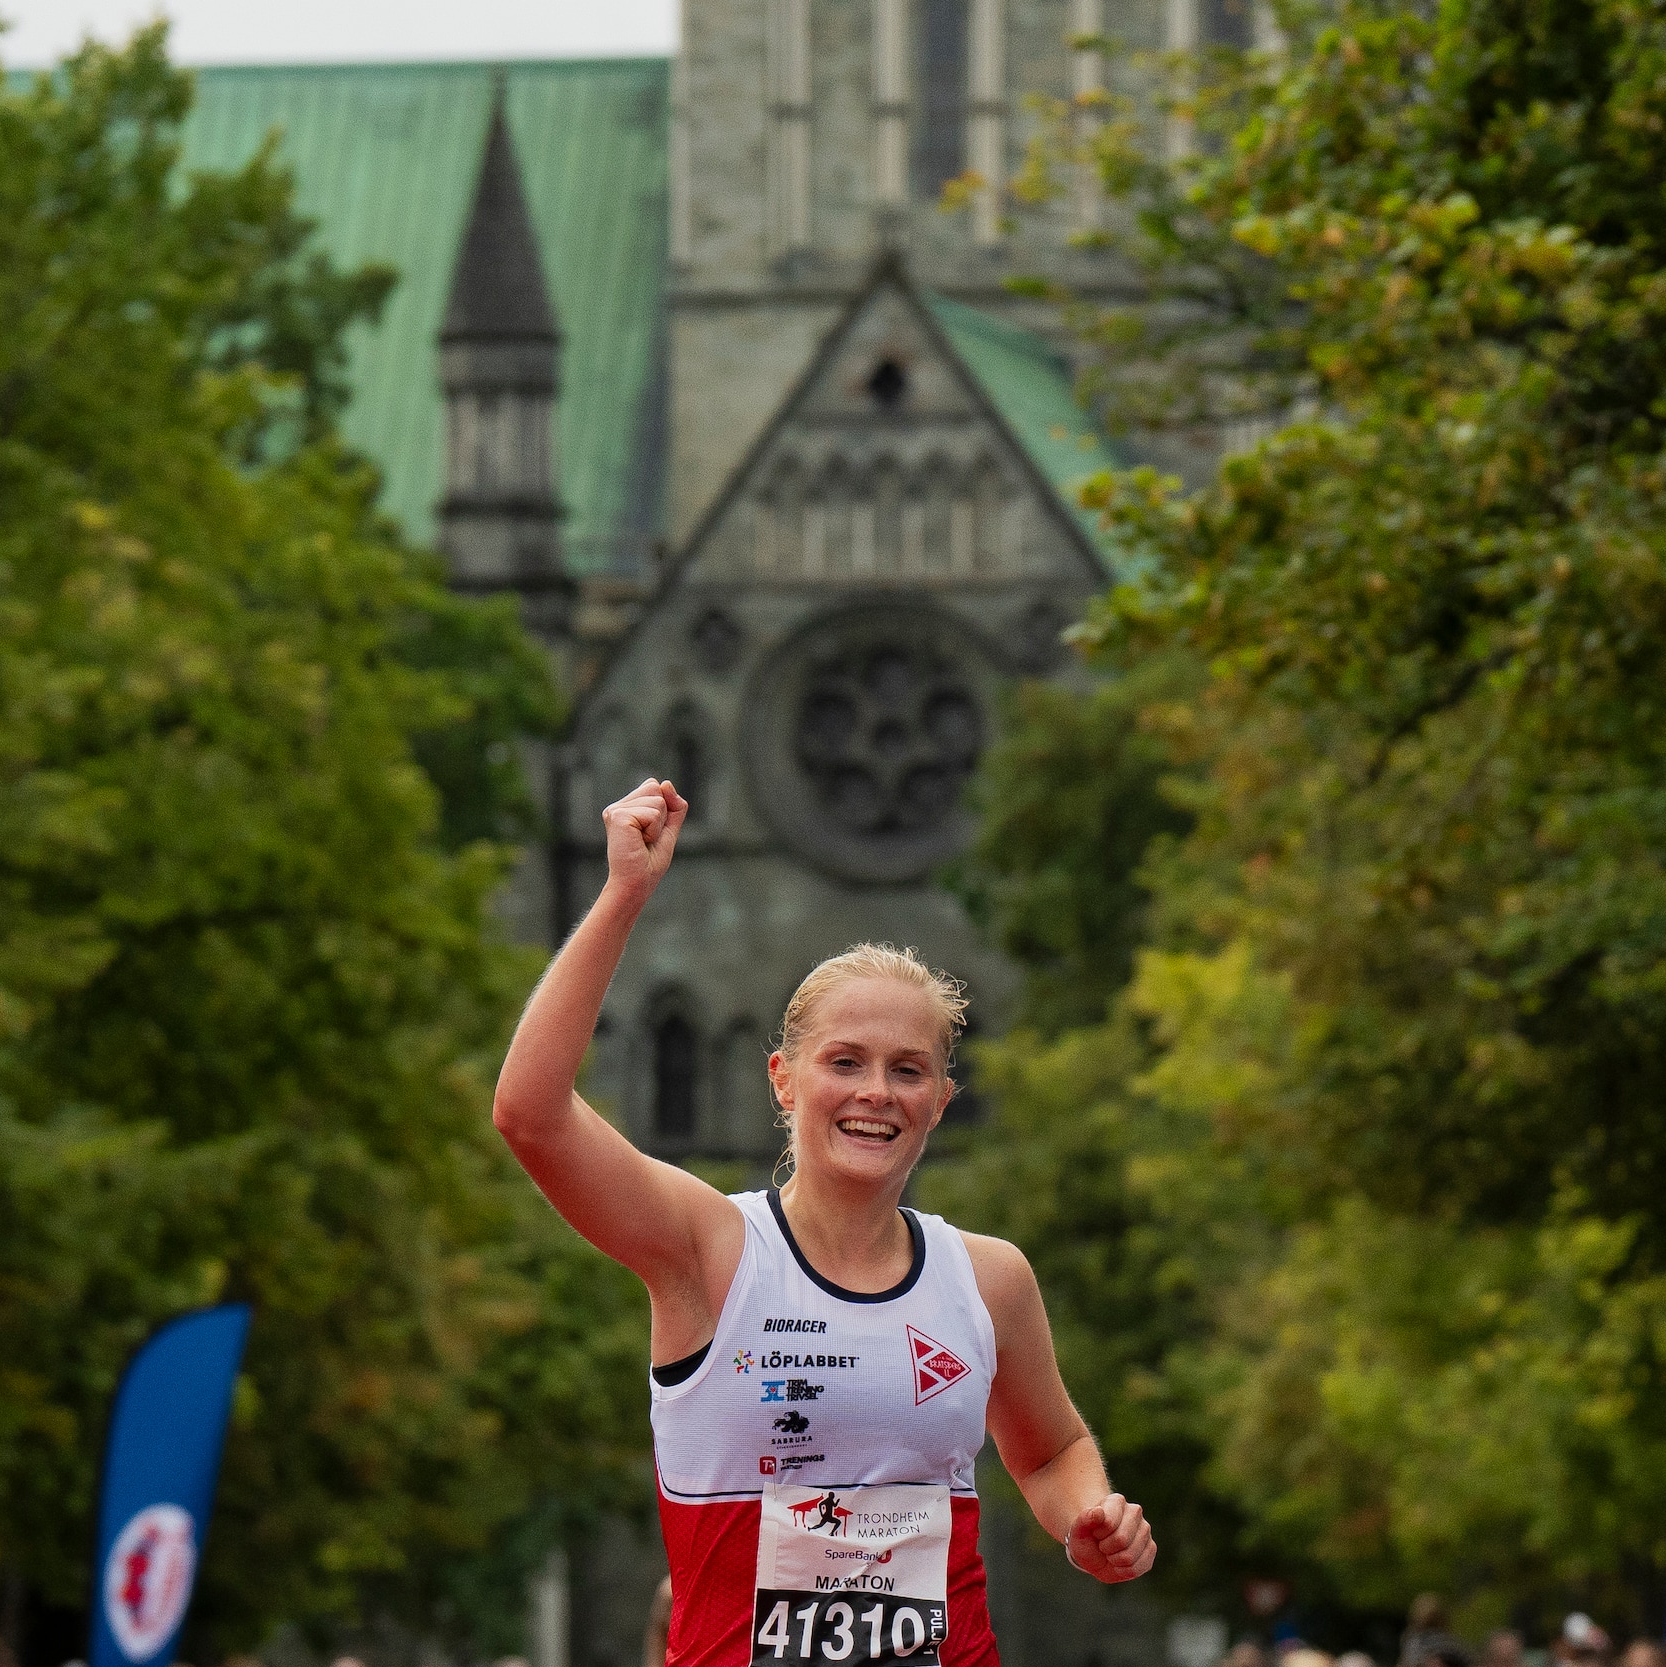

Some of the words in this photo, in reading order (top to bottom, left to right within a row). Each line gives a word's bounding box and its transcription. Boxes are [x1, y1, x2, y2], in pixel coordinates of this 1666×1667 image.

[763, 1318, 827, 1333] BIORACER
[761, 1350, 858, 1369] LÖPLABBET
[786, 1379, 808, 1387] TRIM
[786, 1386, 825, 1394] TRENING
[771, 1435, 813, 1445] SABRURA
[780, 1454, 825, 1465] TRENINGS
[857, 1511, 930, 1524] TRONDHEIM
[857, 1525, 921, 1538] MARATON
[815, 1574, 895, 1592] MARATON
[757, 1600, 926, 1661] 41310
